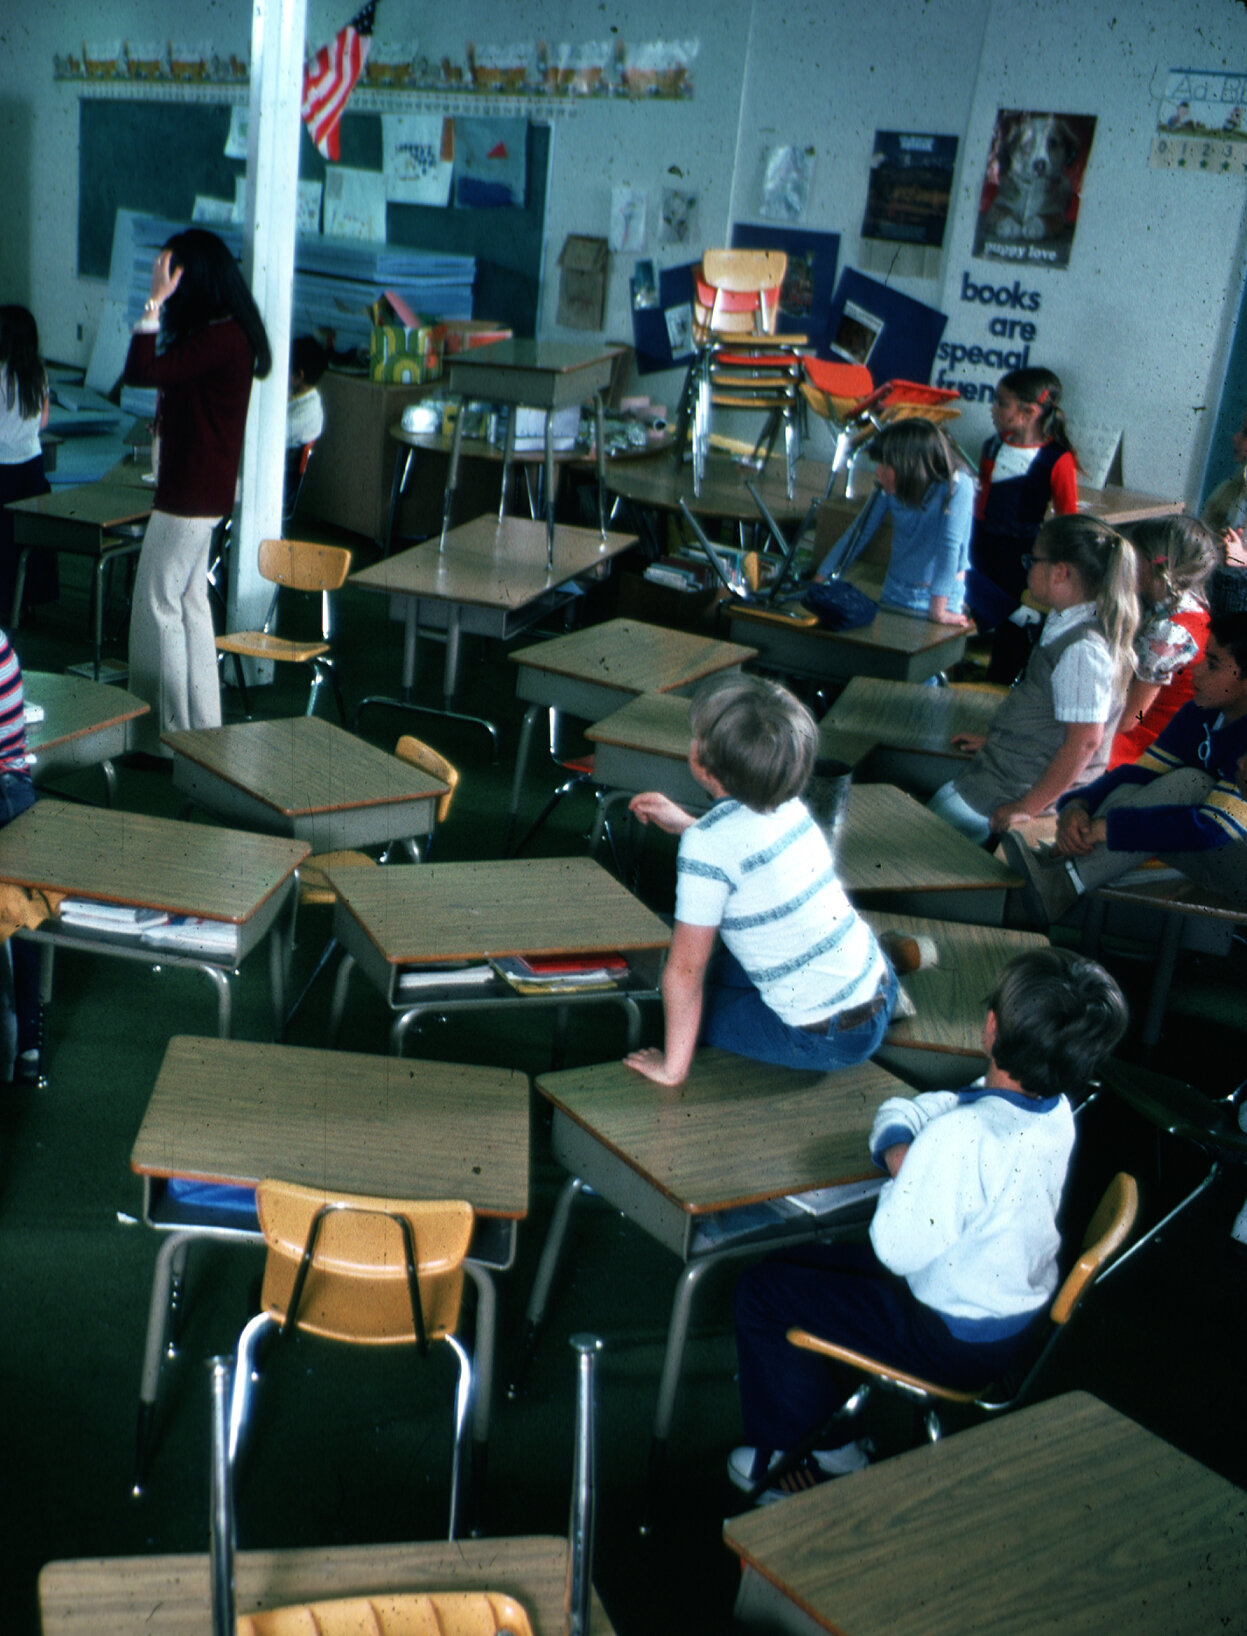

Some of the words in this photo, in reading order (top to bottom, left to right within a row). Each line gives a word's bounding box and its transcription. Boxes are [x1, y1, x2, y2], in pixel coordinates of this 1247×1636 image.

[984, 242, 1026, 259] puppy
[1028, 244, 1057, 261] love
[961, 271, 1042, 312] books
[989, 316, 1037, 342] are
[936, 341, 1031, 371] special
[936, 367, 996, 404] frien
